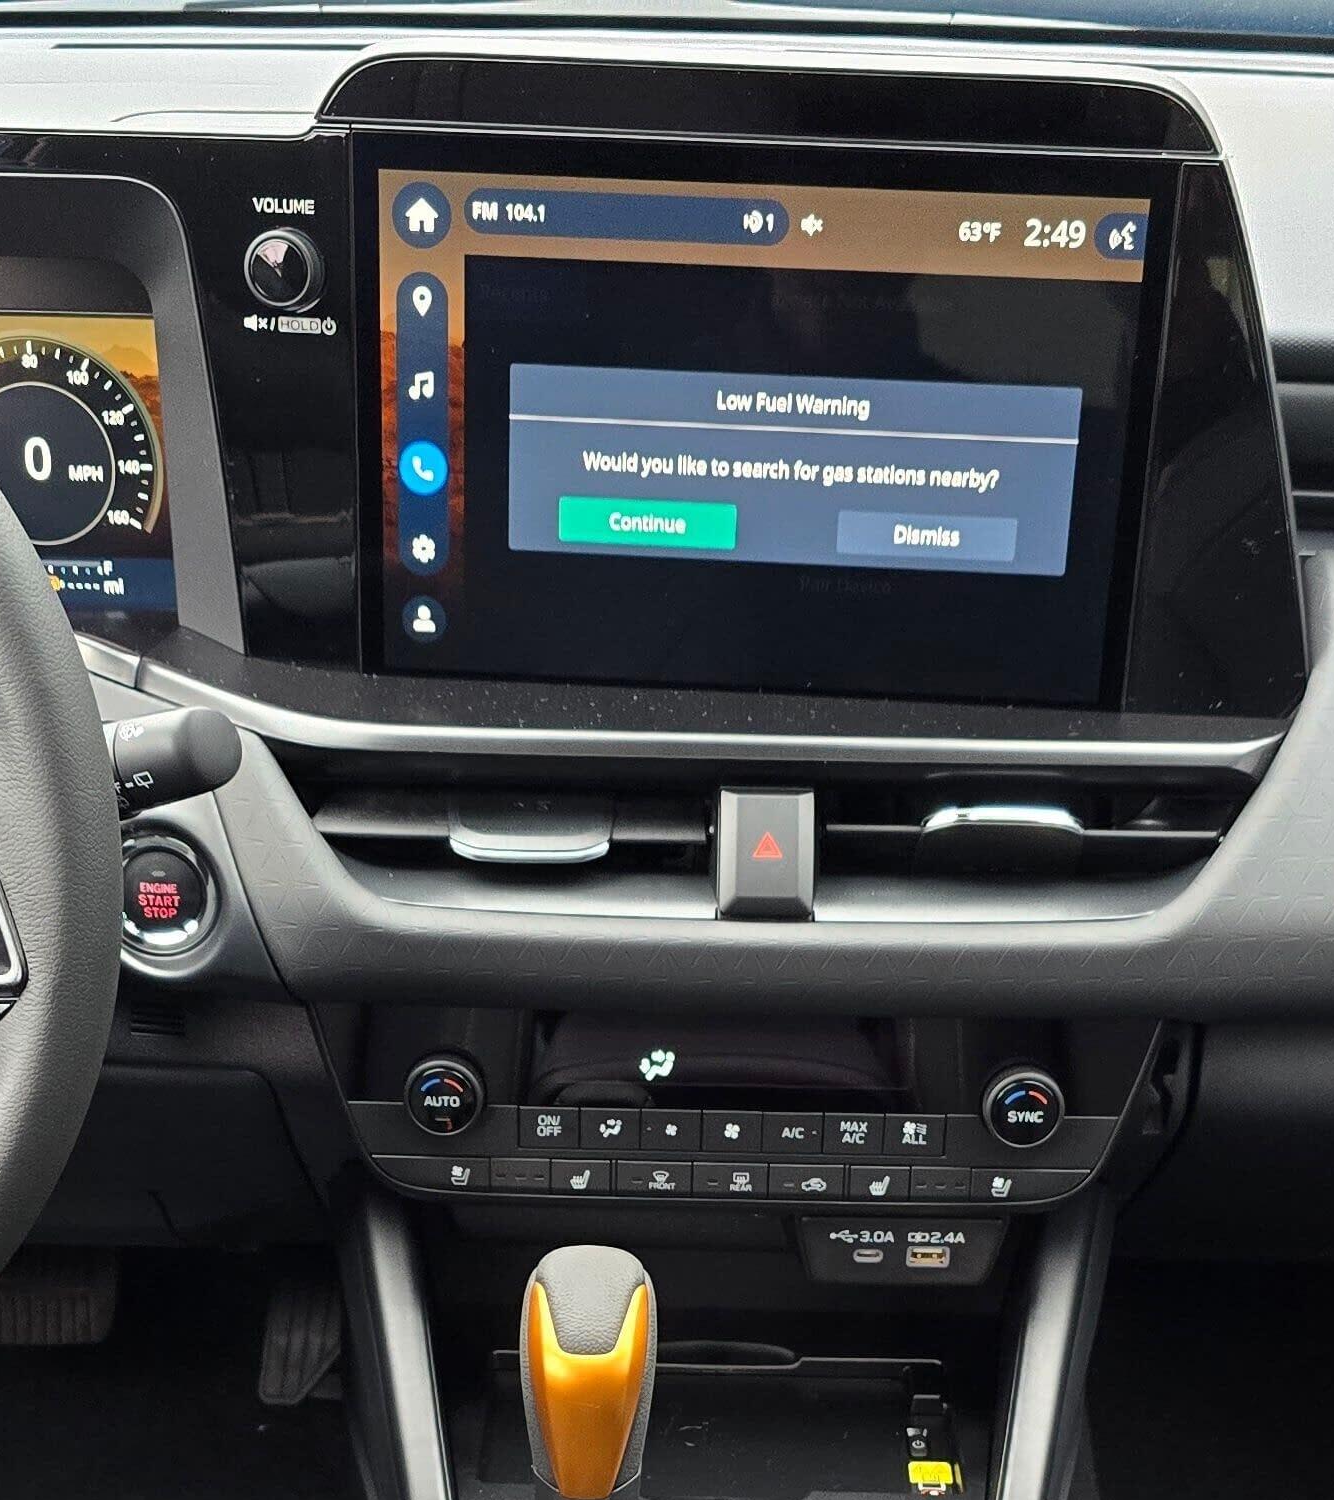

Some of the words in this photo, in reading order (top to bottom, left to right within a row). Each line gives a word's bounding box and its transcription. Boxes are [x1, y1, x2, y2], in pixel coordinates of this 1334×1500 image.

[253, 197, 315, 215] VOLUME
[472, 201, 498, 220] FM
[505, 202, 546, 223] 104.1
[958, 221, 1002, 243] 63°F
[1024, 218, 1086, 249] 2:49
[280, 318, 319, 332] HOLD
[21, 354, 37, 369] 80
[66, 369, 90, 386] 100
[717, 391, 751, 411] Low
[756, 391, 792, 413] Fuel
[796, 394, 870, 420] Warning
[102, 410, 124, 426] 120
[24, 436, 52, 481] 0
[68, 465, 104, 482] MPH
[118, 459, 140, 475] 140
[583, 451, 637, 473] Would
[642, 459, 673, 479] you
[678, 455, 706, 477] like
[711, 459, 729, 477] to
[732, 457, 790, 480] search
[794, 458, 819, 482] for
[822, 466, 853, 488] gas
[857, 462, 926, 487] stations
[930, 467, 1000, 492] nearby?
[107, 510, 130, 526] 160
[608, 511, 687, 535] Continue
[894, 525, 960, 547] Dismiss
[139, 882, 177, 894] ENGINE
[138, 894, 180, 908] START
[144, 907, 177, 919] STOP
[424, 1095, 460, 1108] AUTO
[537, 1115, 561, 1127] ON/
[1007, 1110, 1044, 1123] SYNC
[536, 1125, 562, 1137] OFF
[781, 1127, 805, 1139] A/C
[840, 1121, 868, 1132] MAX
[841, 1132, 865, 1144] A/C
[902, 1134, 927, 1145] ALL
[648, 1181, 676, 1190] FRONT
[730, 1182, 753, 1192] REAR
[859, 1231, 895, 1243] 3.0A
[930, 1232, 966, 1244] 2.4A
